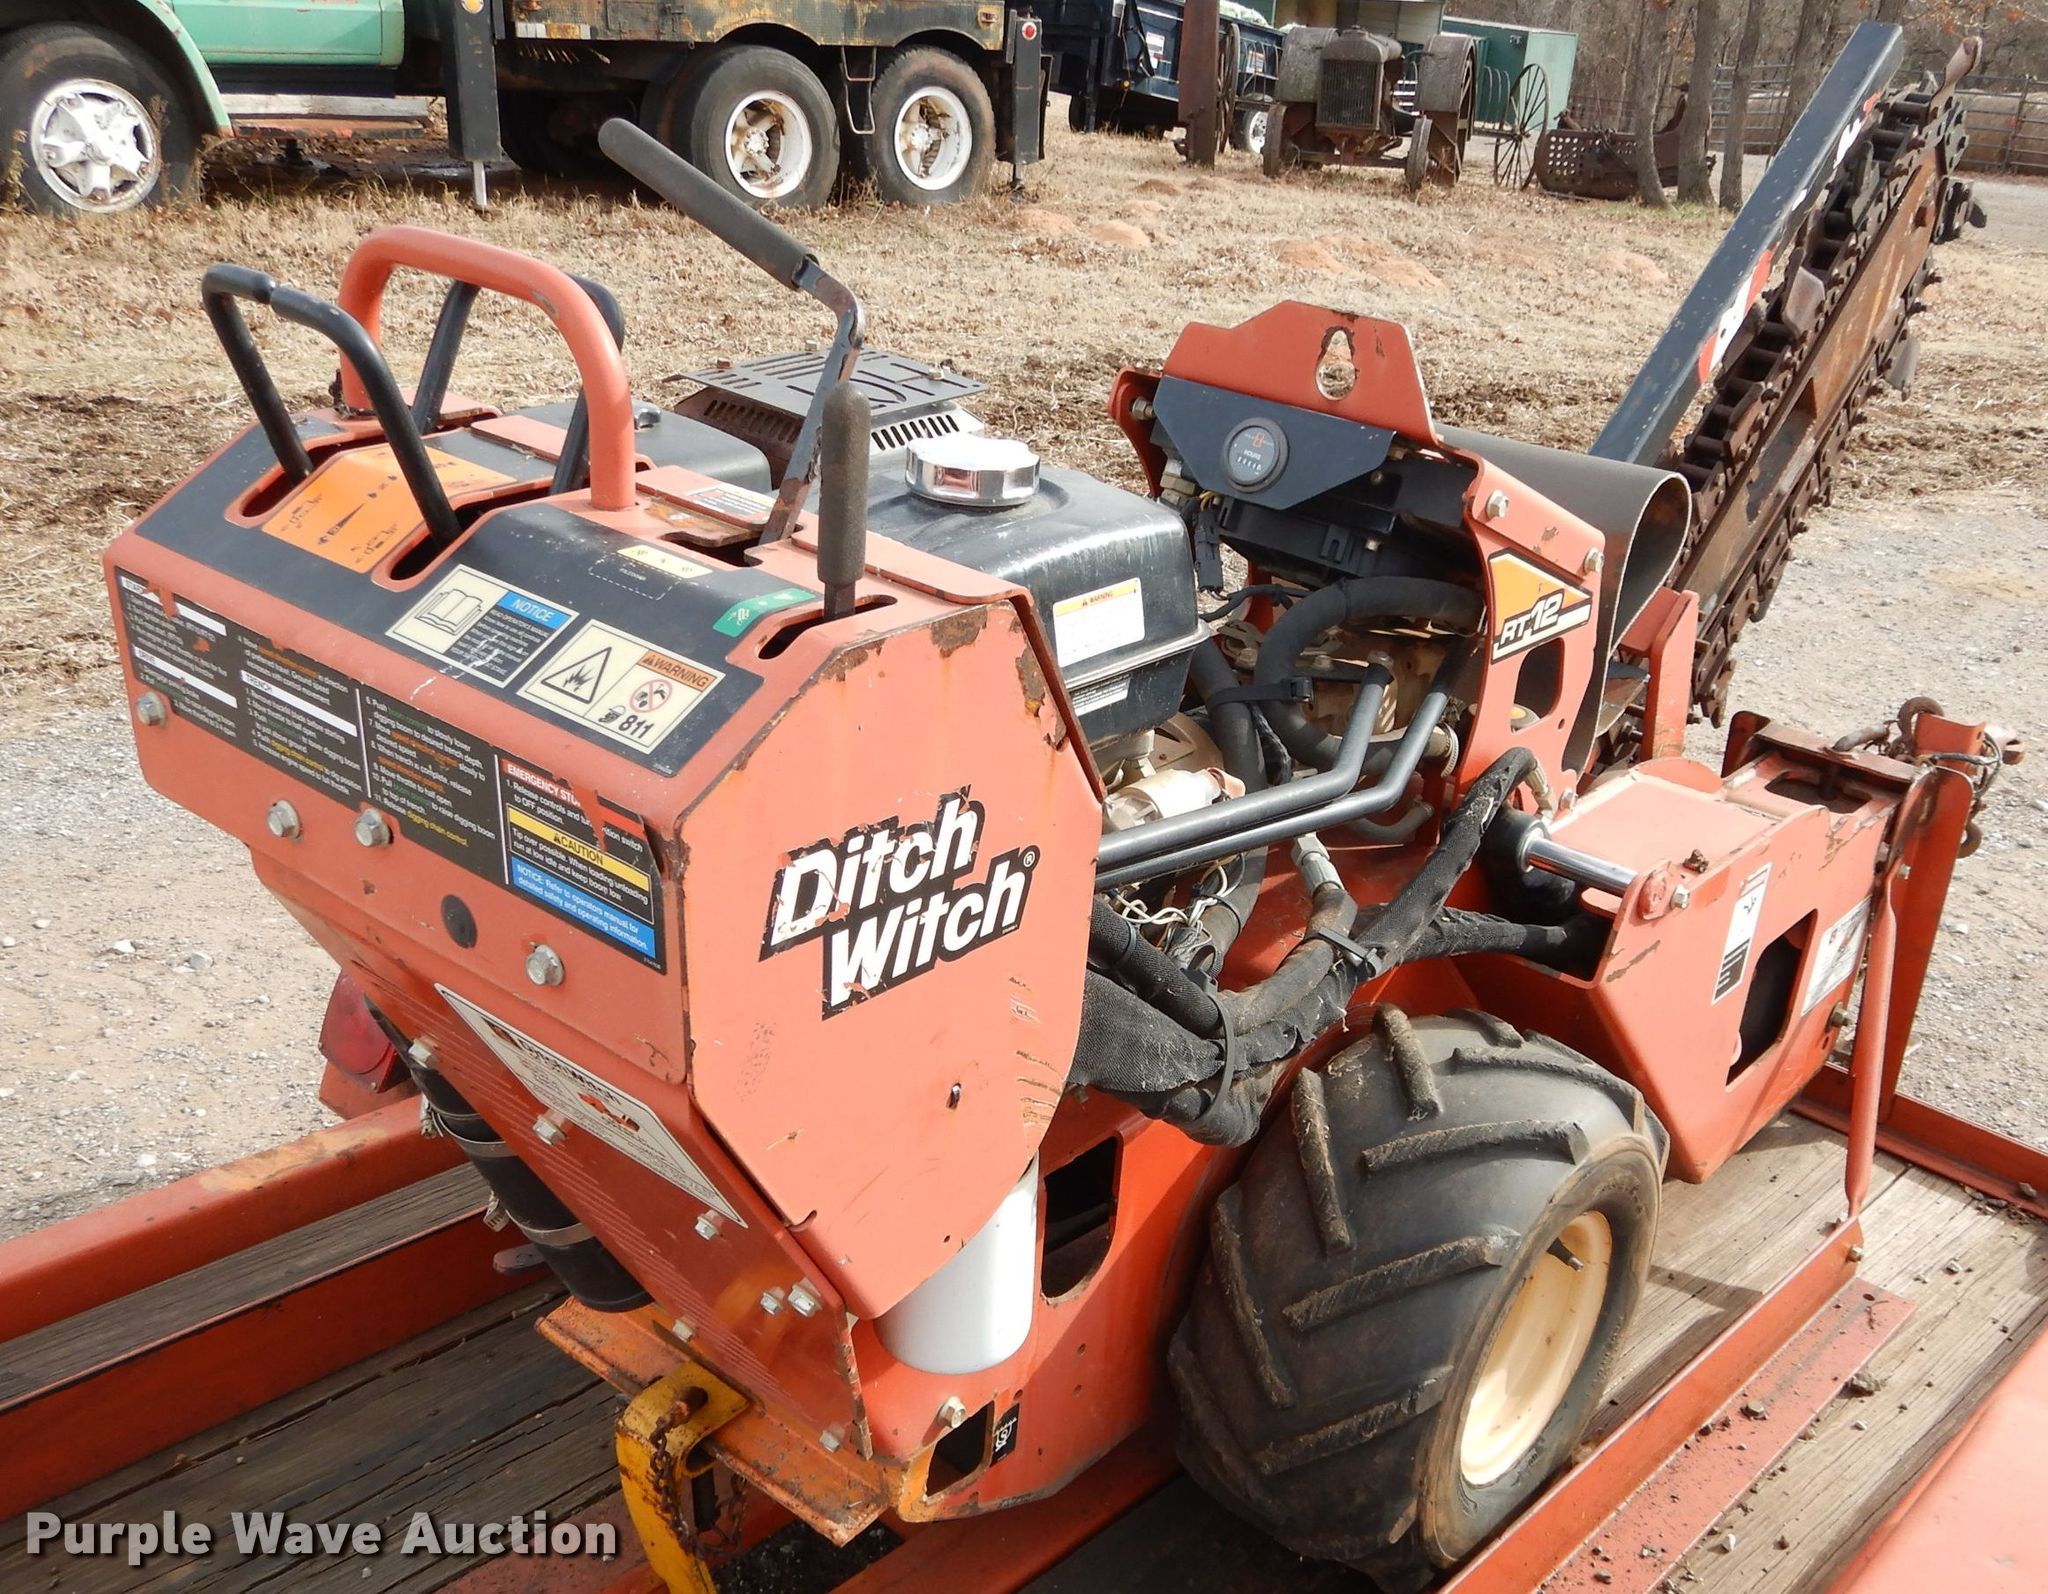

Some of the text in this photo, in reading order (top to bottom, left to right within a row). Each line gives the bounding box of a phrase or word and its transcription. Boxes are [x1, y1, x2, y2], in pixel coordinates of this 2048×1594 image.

[512, 599, 554, 623] NOTICE
[245, 673, 271, 693] TRENCH
[653, 658, 710, 688] WARNING
[618, 714, 655, 740] 811
[507, 762, 580, 808] EMERGENCY STO
[506, 778, 512, 789] 1.
[513, 781, 538, 802] Release
[539, 794, 565, 815] controls
[566, 808, 579, 822] and
[621, 835, 642, 853] switch
[514, 793, 564, 826] to OFF position.
[512, 827, 523, 841] Tip
[523, 833, 537, 847] over
[538, 840, 567, 863] possible.
[568, 855, 588, 873] When
[512, 838, 623, 902] run at low idle and keep boom low.
[558, 834, 603, 866] CAUTION
[770, 798, 978, 946] Ditch
[517, 864, 544, 885] NOTICE:
[545, 878, 562, 894] Refer
[563, 887, 570, 898] to
[603, 908, 628, 928] manual
[628, 921, 638, 934] for
[518, 875, 648, 951] detailed safety and operating information.
[830, 860, 1016, 1007] Witch
